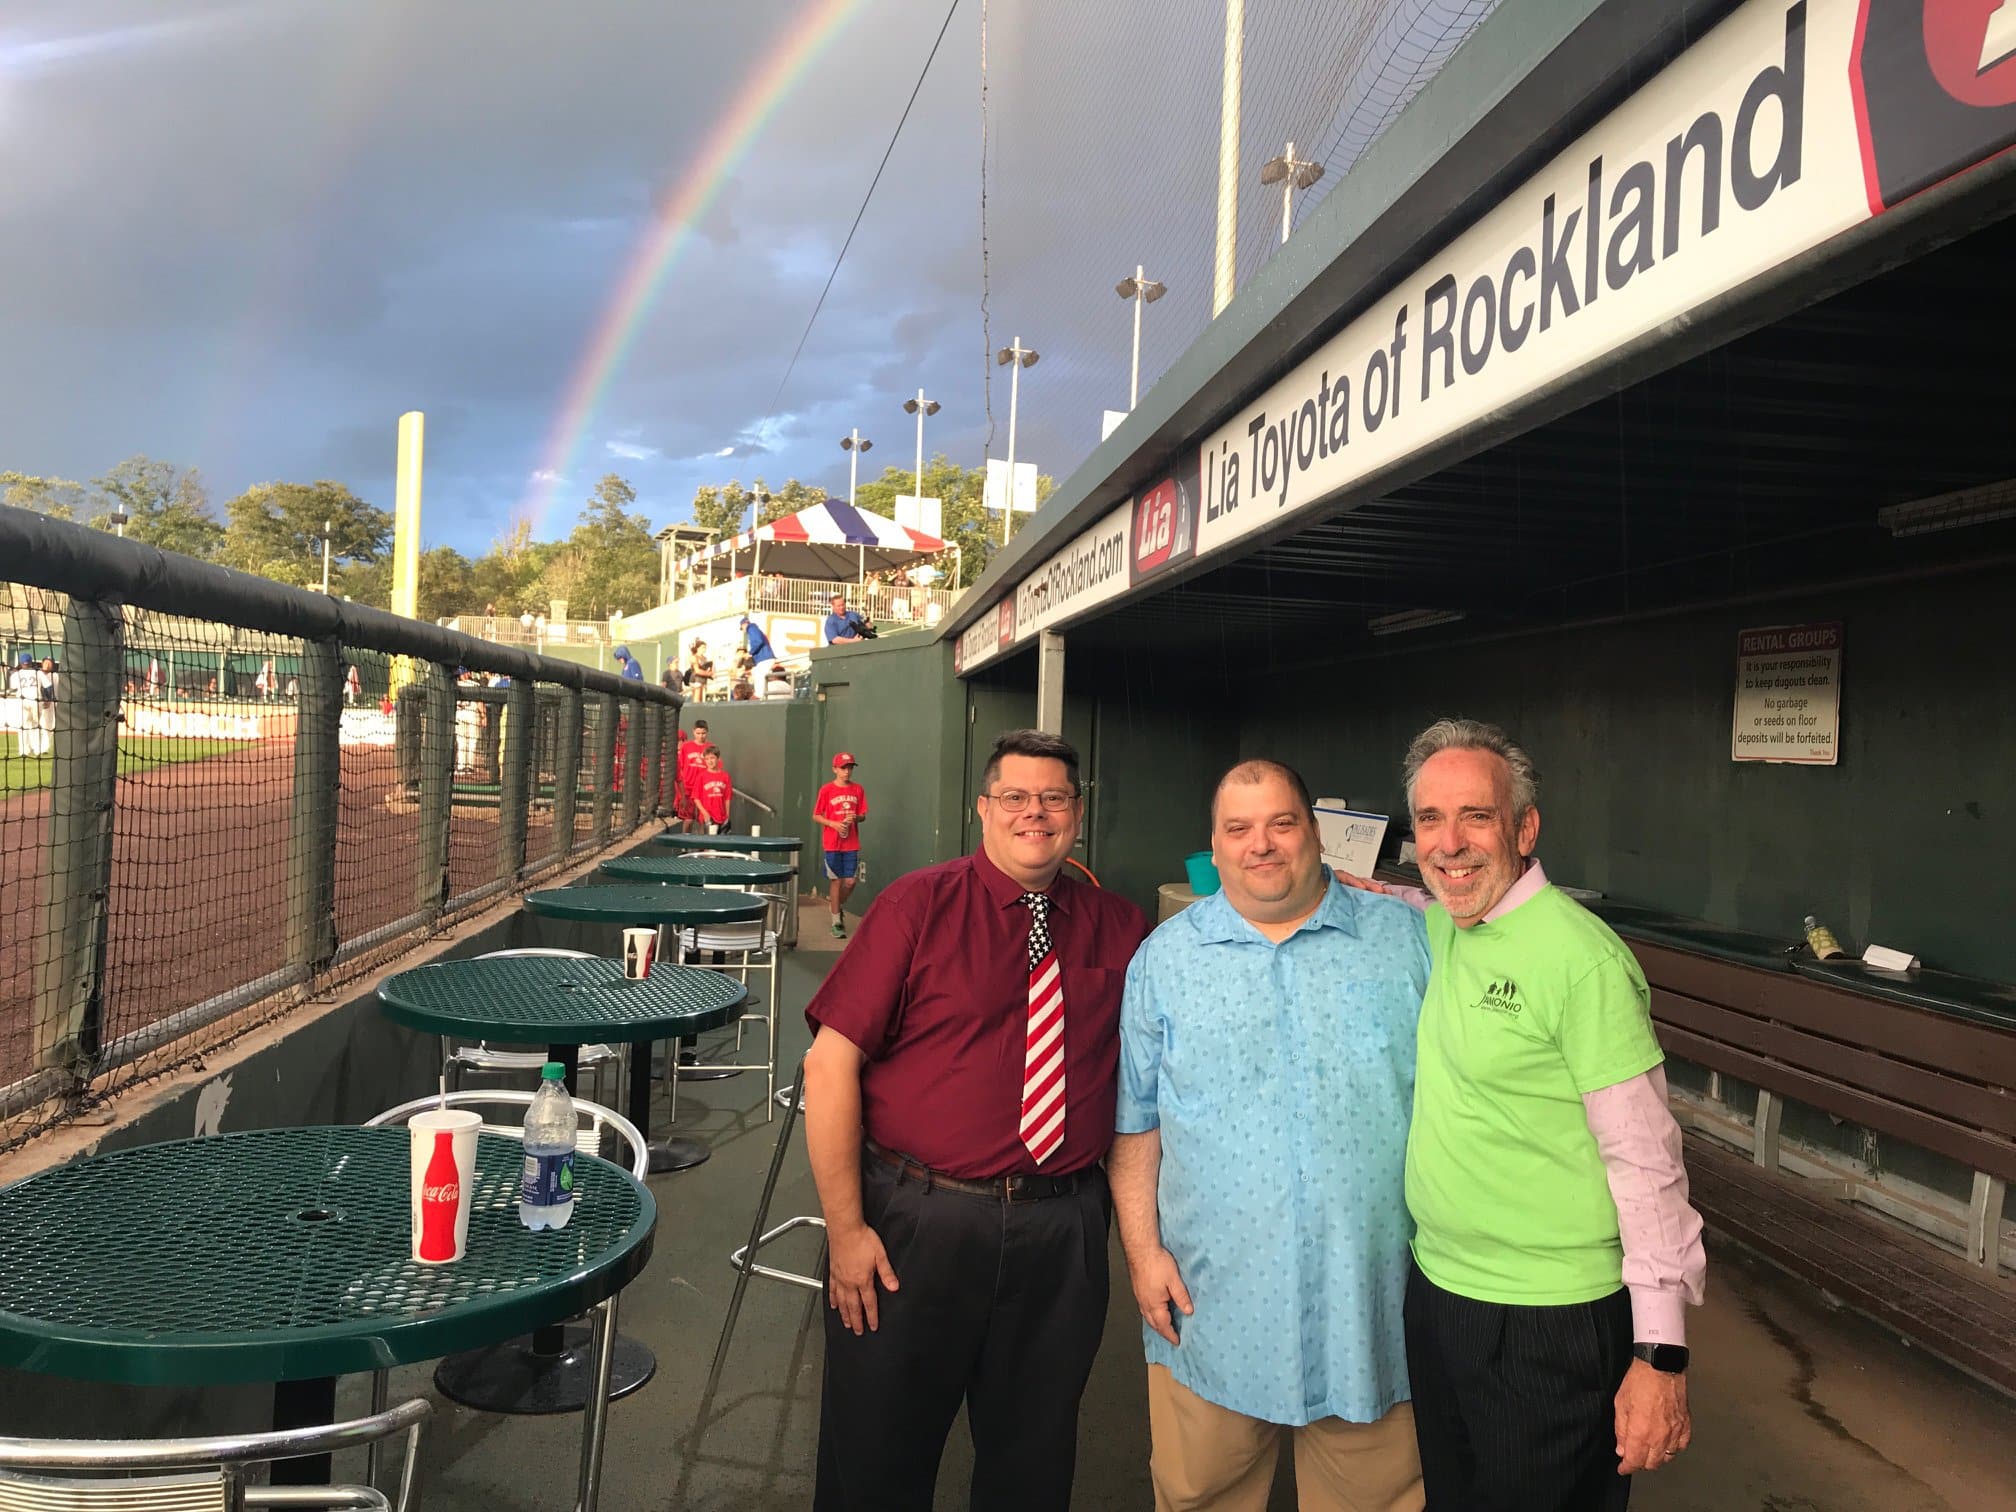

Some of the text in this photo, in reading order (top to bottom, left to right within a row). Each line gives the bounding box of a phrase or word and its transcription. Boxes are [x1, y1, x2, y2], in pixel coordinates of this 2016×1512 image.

[1207, 0, 1807, 523] Lia Toyota of Rockland
[1138, 491, 1171, 560] Lia
[1743, 629, 1836, 652] RENTAL GROUPS
[1746, 656, 1832, 674] It is your responsibility
[20, 676, 37, 687] 22
[1745, 674, 1830, 690] to keep dugouts clean.
[1764, 697, 1808, 711] No garbage
[1754, 714, 1817, 726] or seeds on floor
[1737, 732, 1832, 745] deposits will be forfeited.
